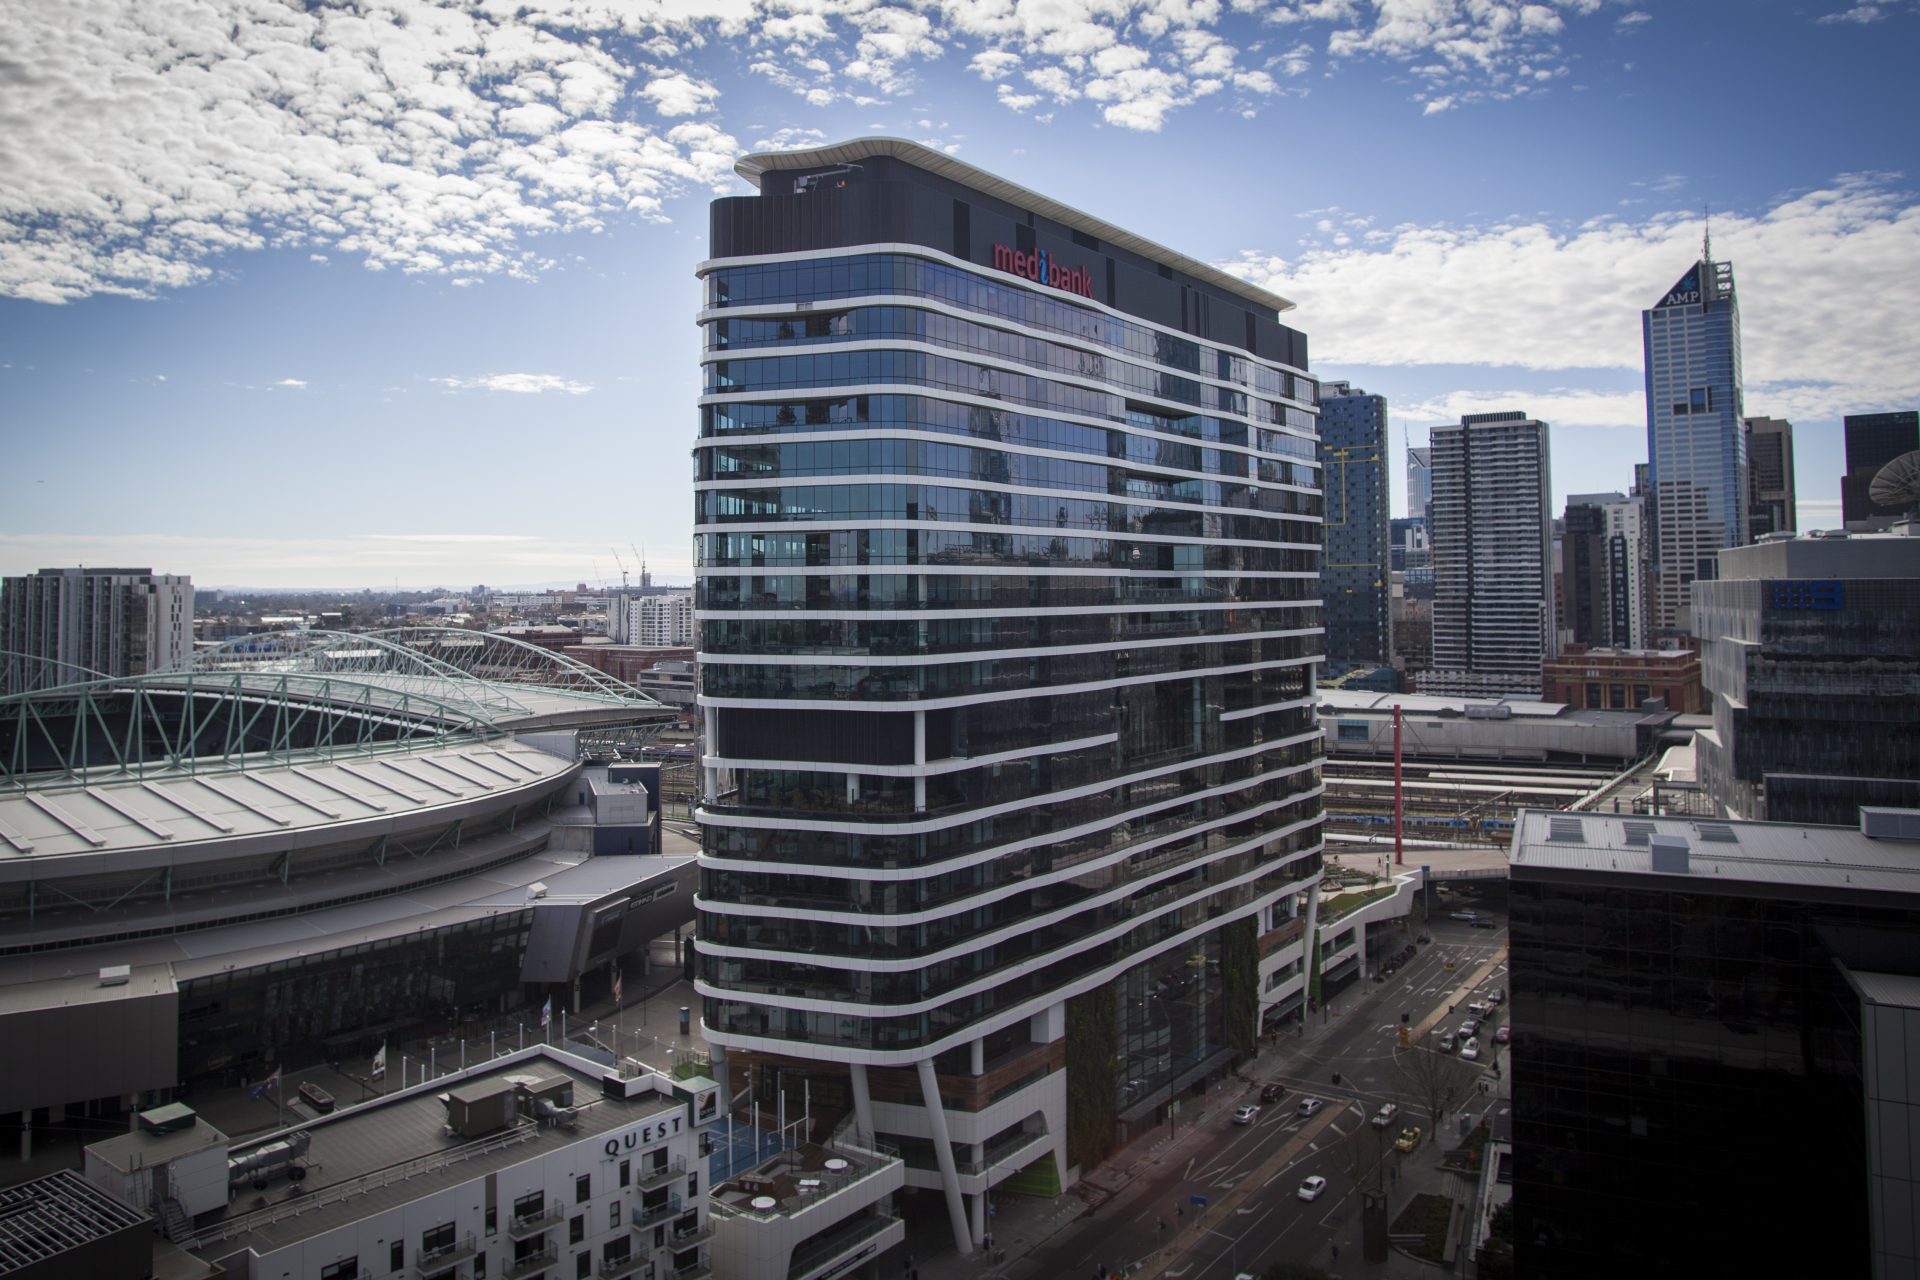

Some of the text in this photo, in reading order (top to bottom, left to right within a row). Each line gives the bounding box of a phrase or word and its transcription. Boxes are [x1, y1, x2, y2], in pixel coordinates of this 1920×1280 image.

[993, 241, 1094, 299] medibank
[1666, 291, 1699, 305] AMP
[605, 1117, 682, 1157] QUEST
